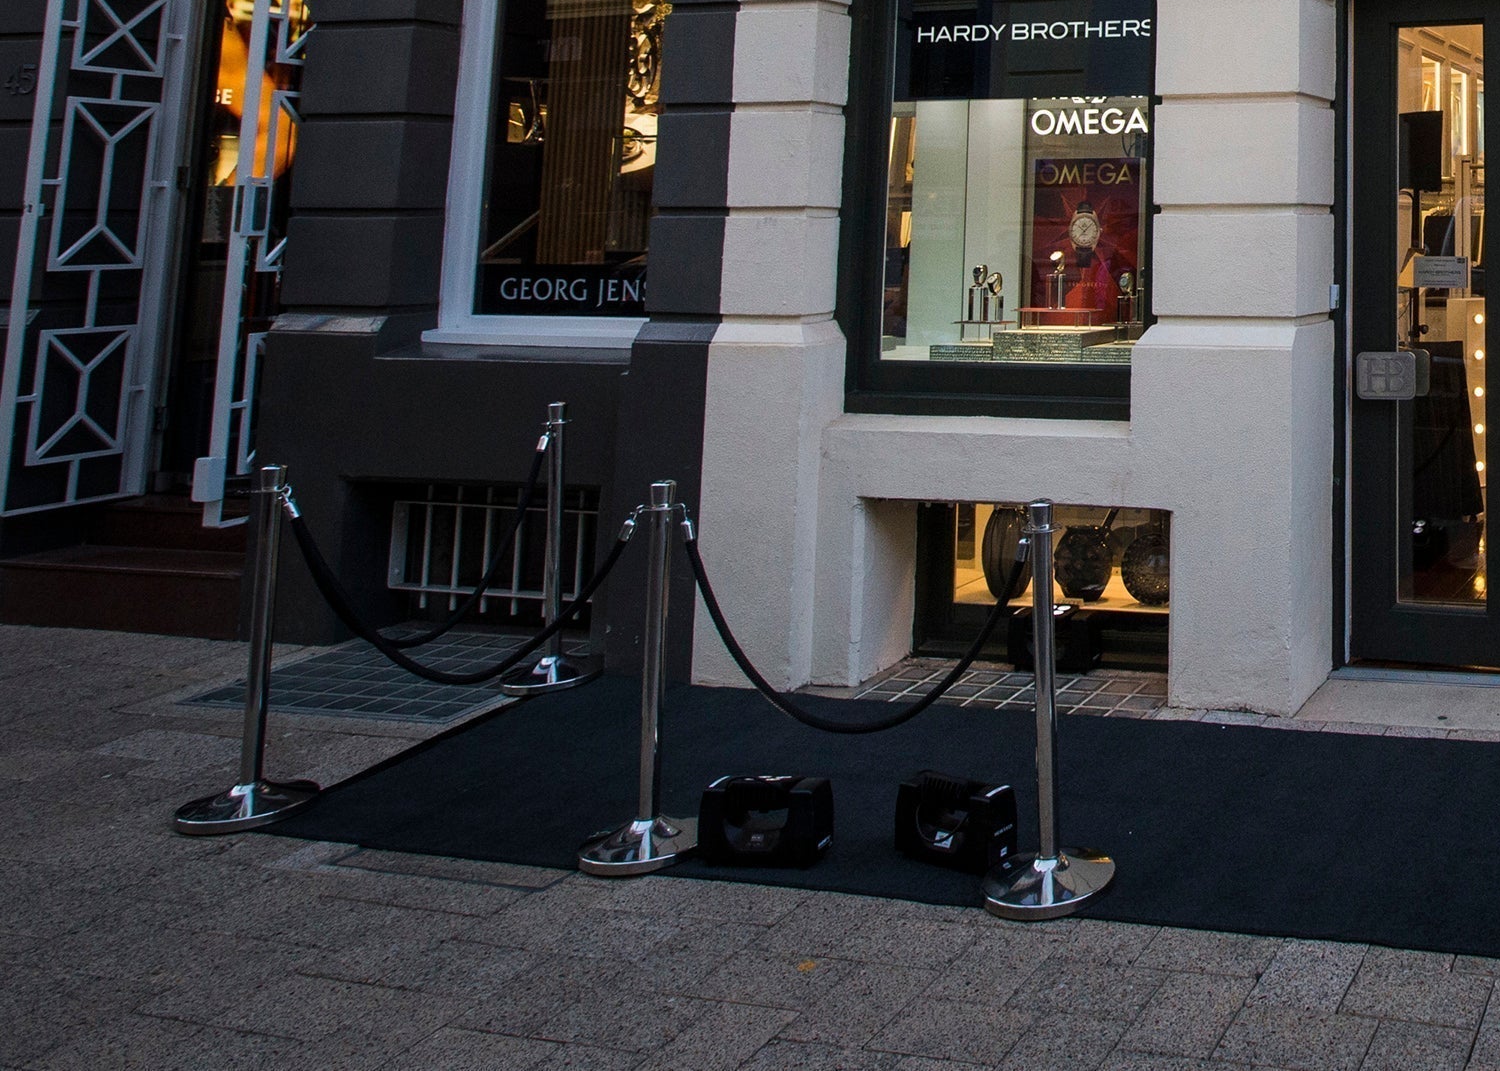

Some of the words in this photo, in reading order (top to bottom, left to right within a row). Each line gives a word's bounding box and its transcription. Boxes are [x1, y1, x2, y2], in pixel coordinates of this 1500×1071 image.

[917, 23, 1007, 43] HARDY
[3, 63, 37, 95] 45
[1031, 107, 1149, 135] OMEGA
[1039, 162, 1134, 185] OMEGA
[500, 277, 588, 301] GEORG
